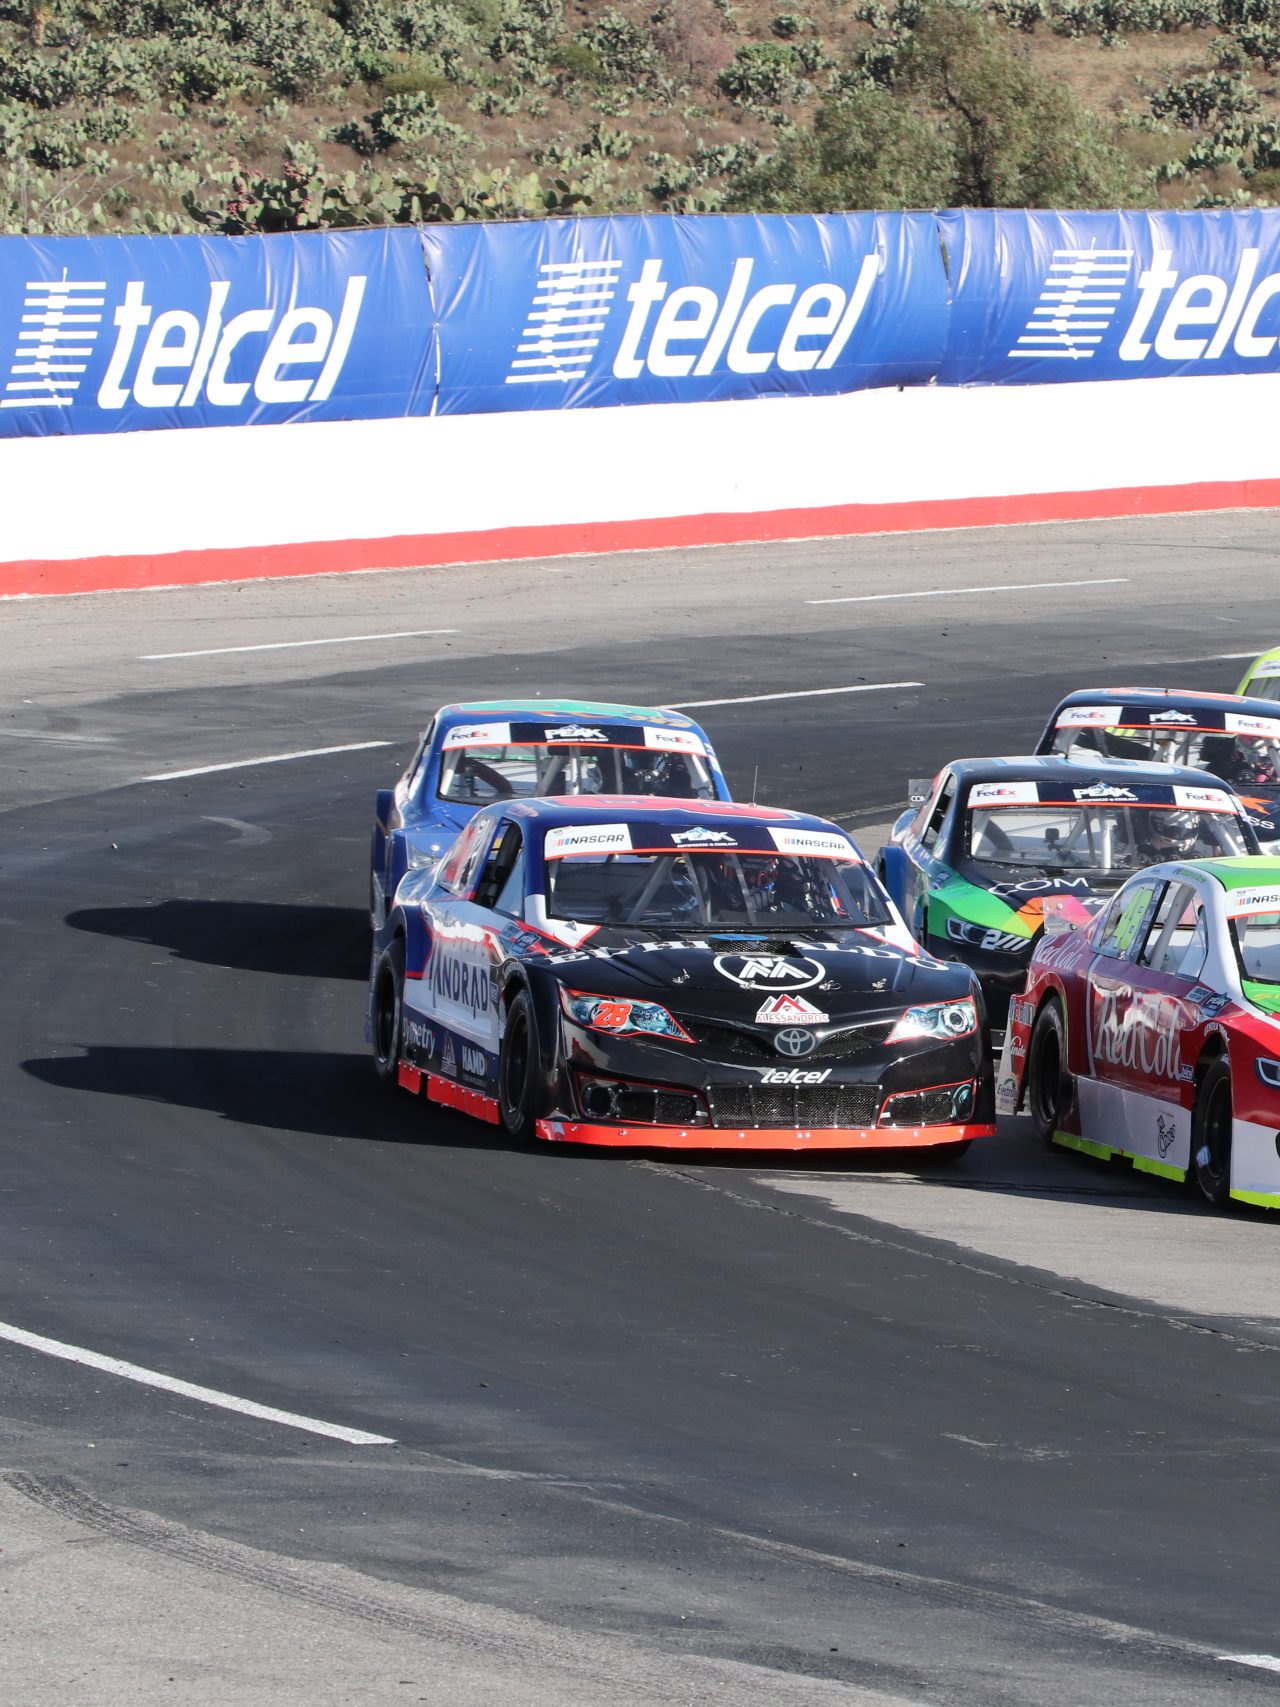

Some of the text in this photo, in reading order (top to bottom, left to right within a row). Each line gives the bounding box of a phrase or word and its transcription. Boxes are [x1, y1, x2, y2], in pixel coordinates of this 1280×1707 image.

[612, 255, 879, 379] telcel
[97, 275, 366, 409] telcel
[1149, 711, 1198, 723] PEAK
[451, 730, 489, 741] FedEx
[544, 727, 607, 740] PEAK
[656, 733, 693, 745] FedEx
[976, 788, 1016, 798] FedEx
[1072, 785, 1134, 800] PEAK
[1185, 791, 1224, 803] FedEx
[569, 833, 625, 845] NASCAR
[670, 828, 738, 843] PEAK
[796, 838, 845, 850] NASCAR
[593, 1001, 630, 1028] 28
[754, 1013, 830, 1024] ALESSANDROS
[760, 1068, 833, 1084] telcel
